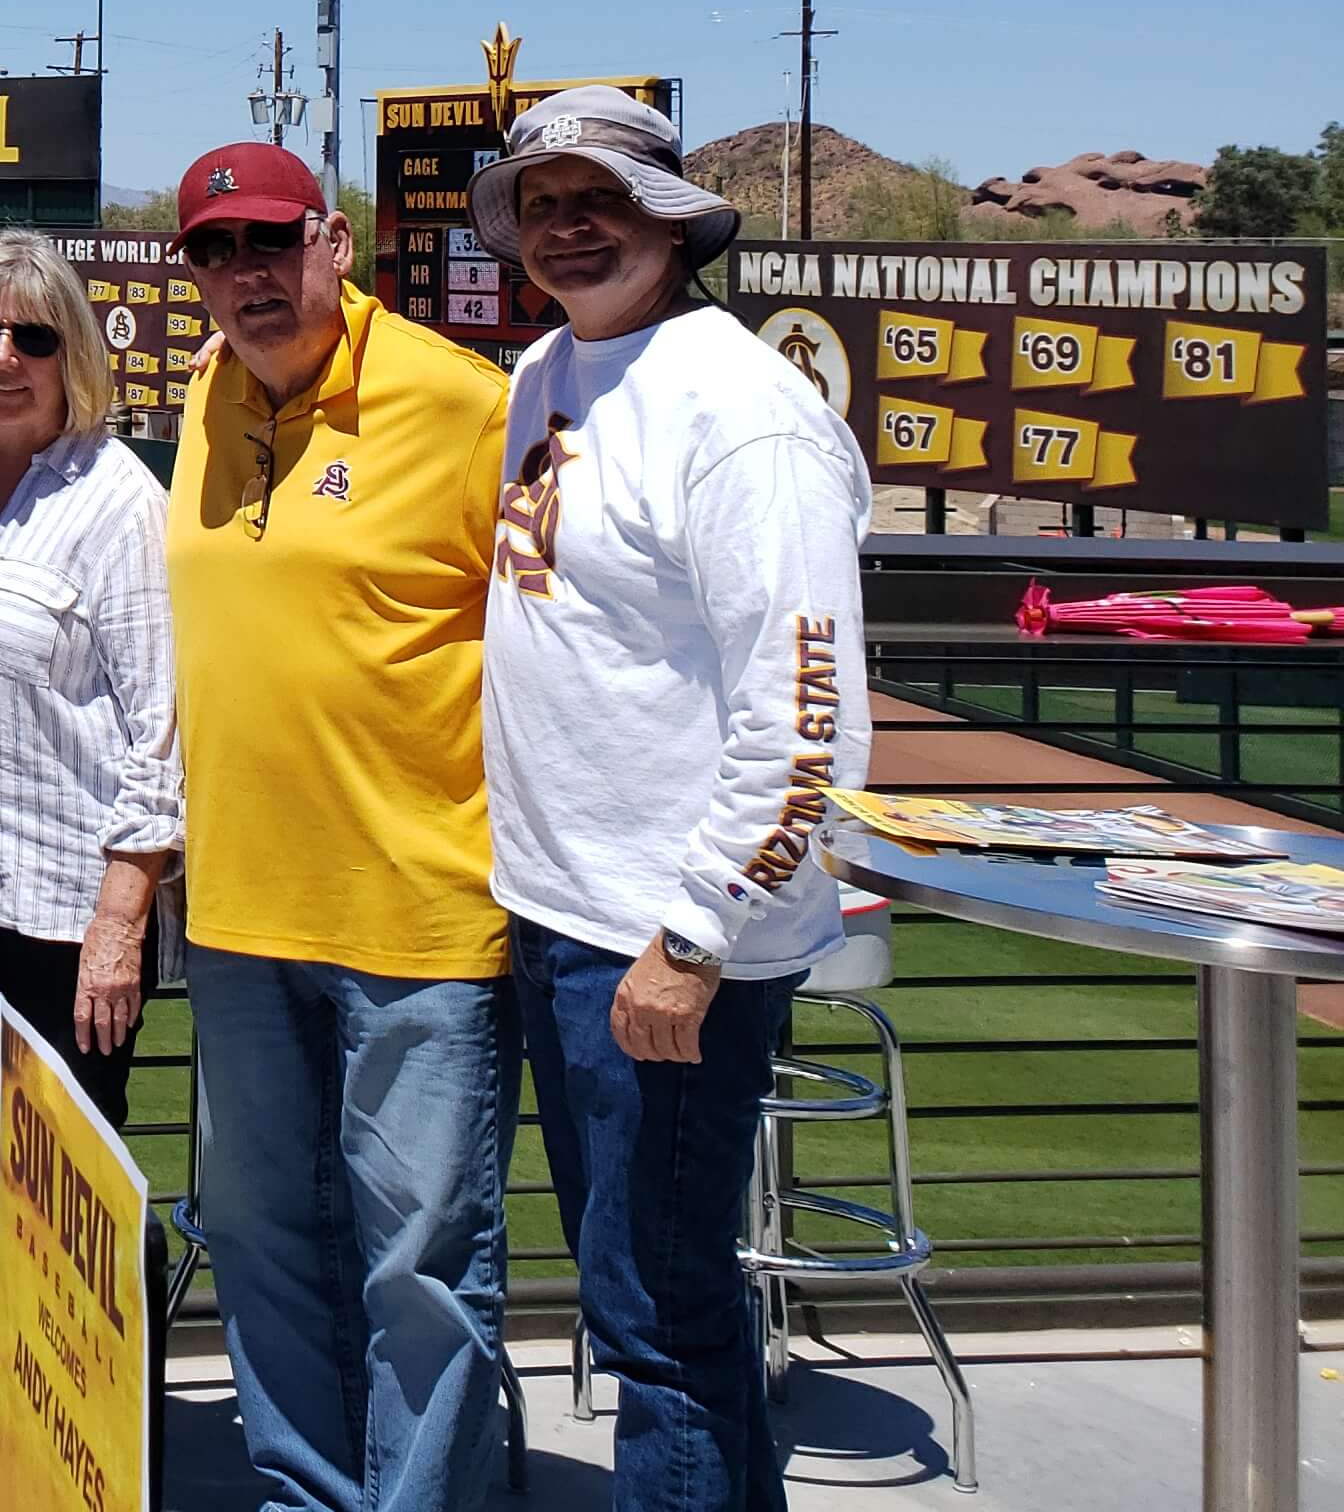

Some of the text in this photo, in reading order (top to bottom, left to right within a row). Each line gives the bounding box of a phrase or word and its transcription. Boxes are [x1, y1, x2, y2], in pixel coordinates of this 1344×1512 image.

[387, 103, 425, 129] SUN
[430, 101, 484, 127] DEVIL
[403, 158, 439, 176] GAGE
[404, 191, 468, 209] WORKMA
[100, 240, 161, 264] WORLD
[408, 232, 434, 253] AVG
[410, 264, 478, 286] HR 8
[738, 251, 1305, 315] NCAA NATIONAL CHAMPIONS
[408, 297, 484, 319] RBI 42
[885, 325, 1235, 383] '65 '69 '81
[885, 411, 1080, 468] '67 '77
[796, 614, 840, 743] STATE
[742, 752, 834, 891] RIZONA
[10, 1086, 124, 1341] SUN DEVIL
[16, 1213, 115, 1385] BASEBALL
[38, 1296, 87, 1399] WELCOMES
[14, 1330, 105, 1512] ANDY HAYES
